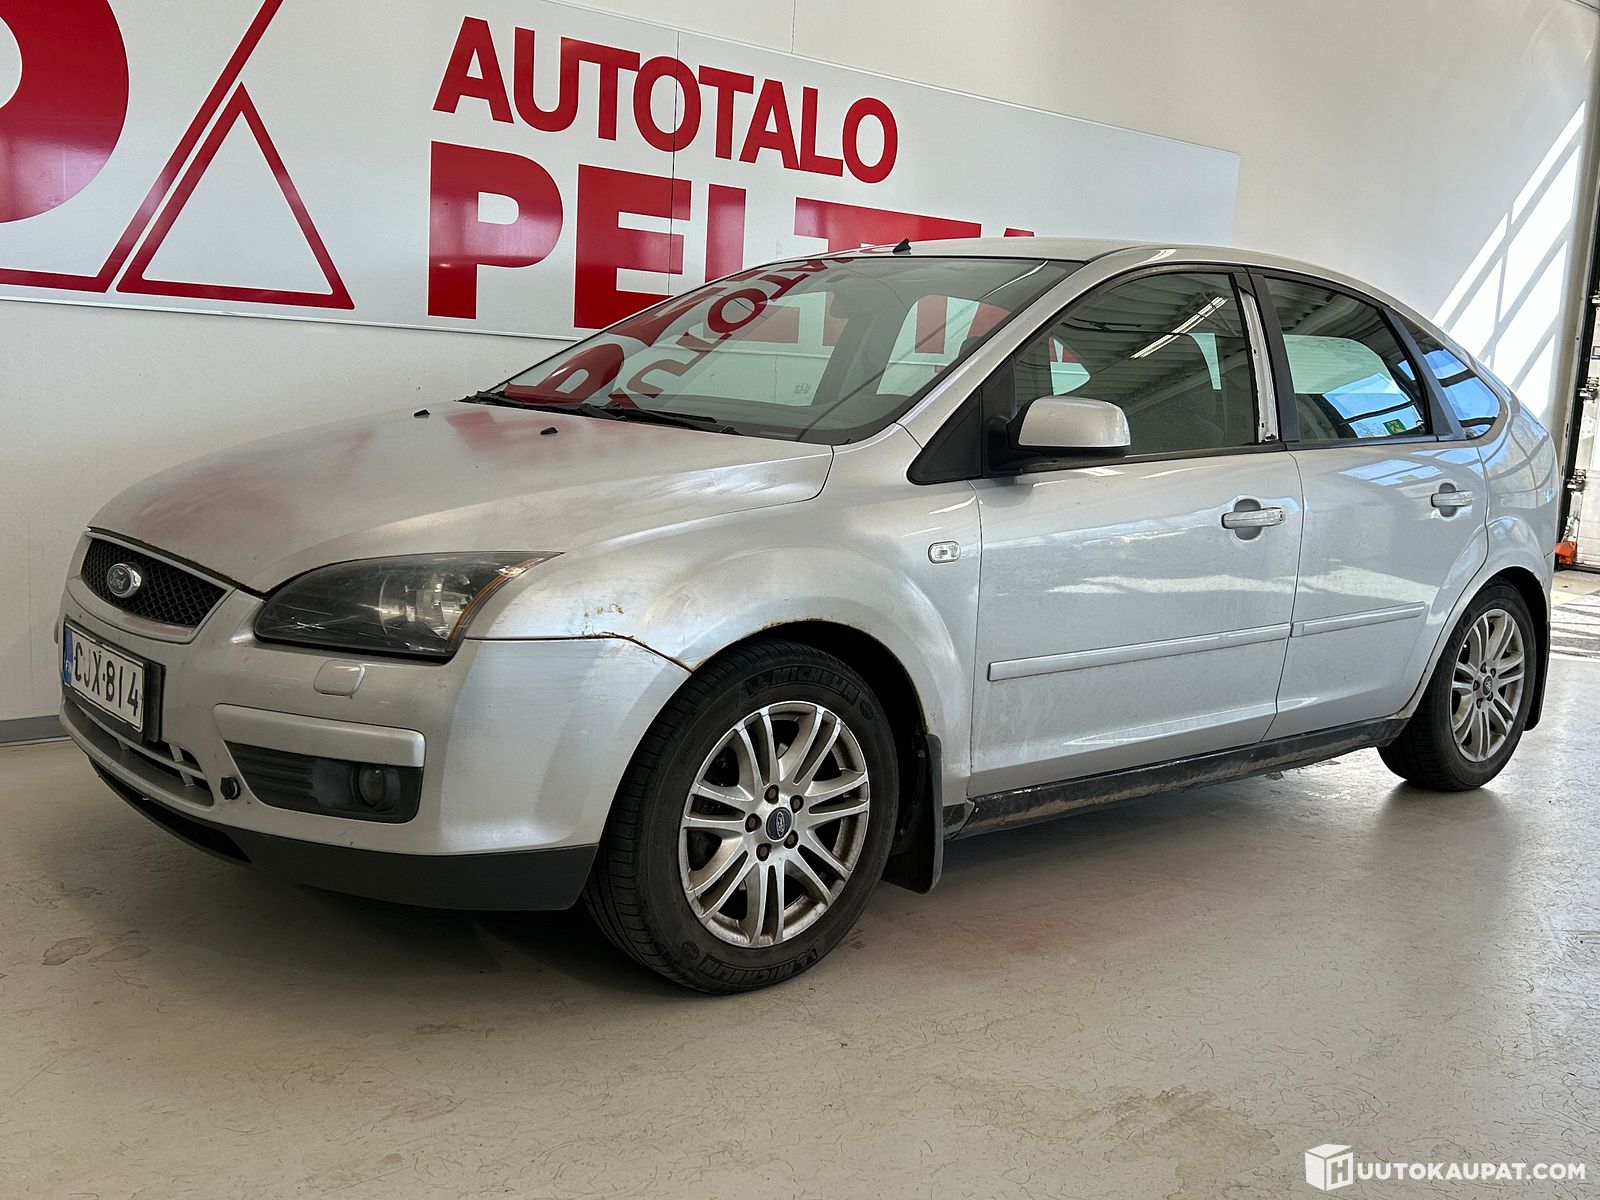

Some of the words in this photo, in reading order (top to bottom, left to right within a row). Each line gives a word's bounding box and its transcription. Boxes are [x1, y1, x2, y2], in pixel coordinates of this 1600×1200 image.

[432, 16, 898, 184] AUTOTALO
[771, 666, 860, 704] MICHELIN
[698, 954, 795, 984] MICHELIN
